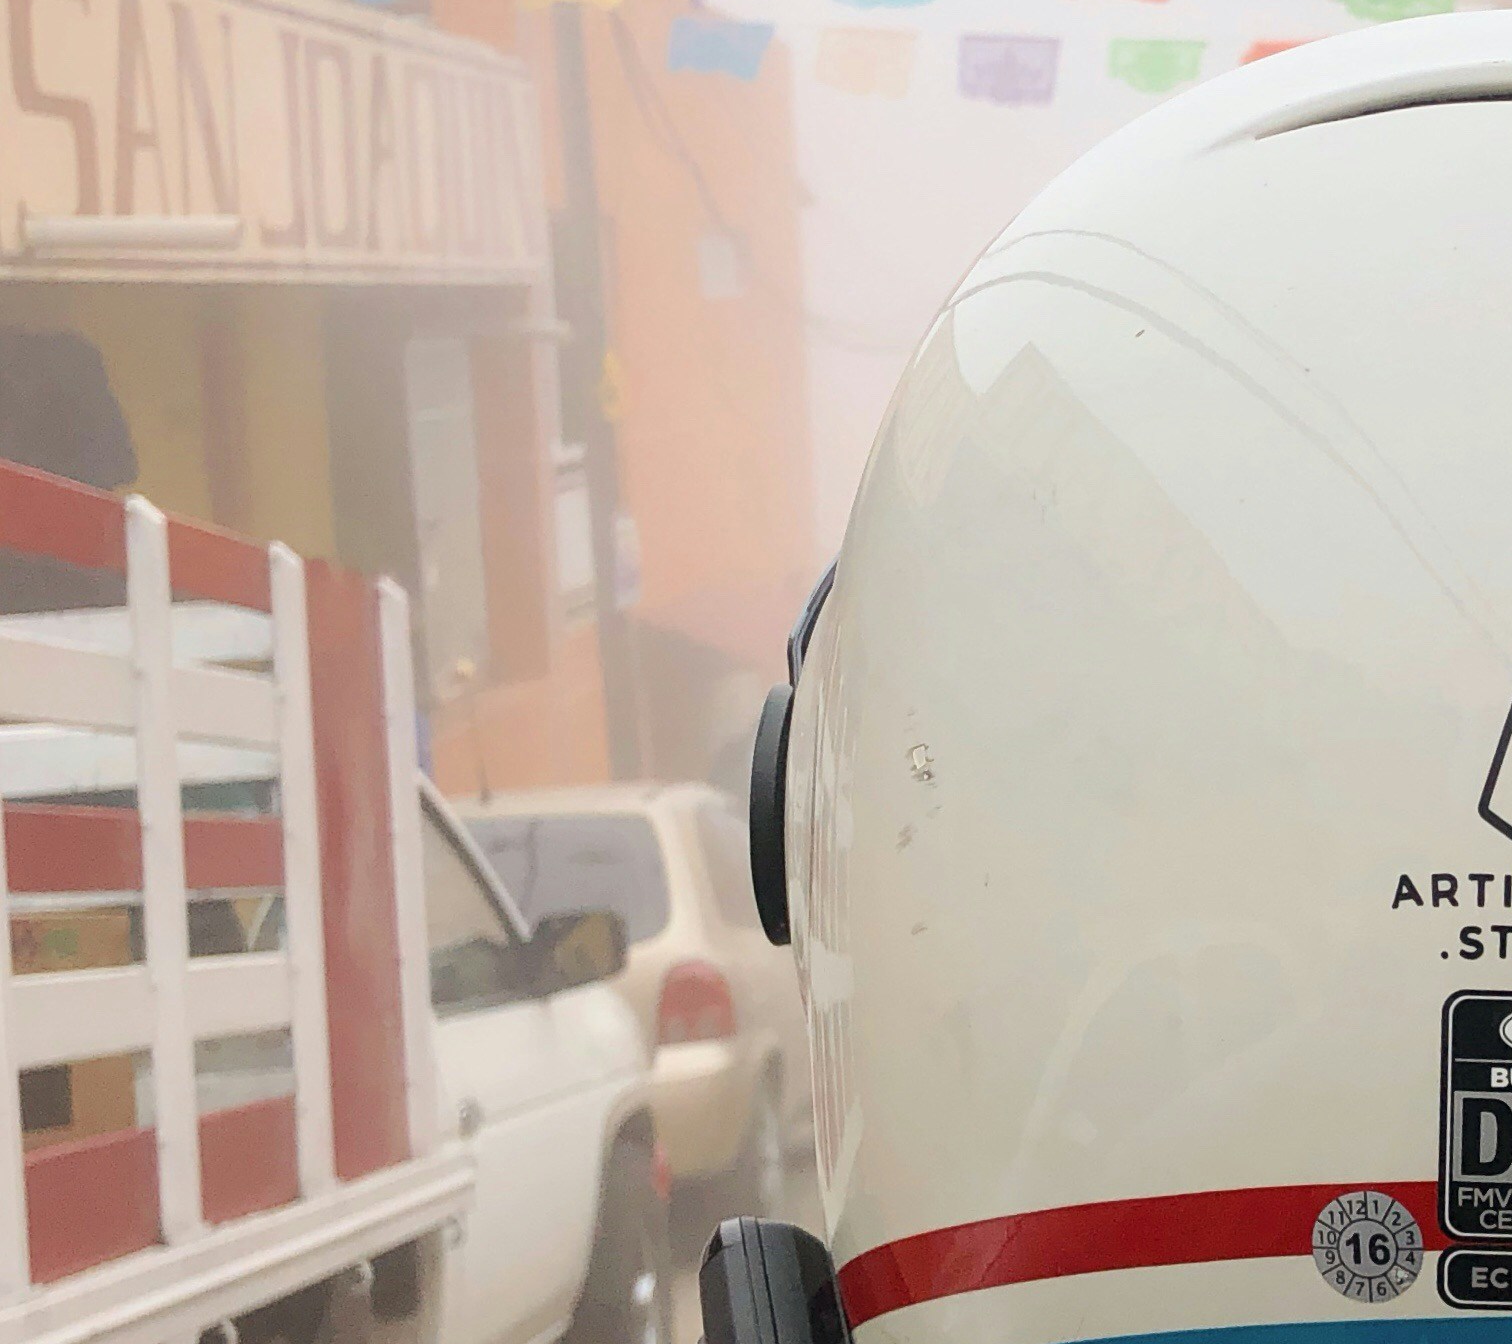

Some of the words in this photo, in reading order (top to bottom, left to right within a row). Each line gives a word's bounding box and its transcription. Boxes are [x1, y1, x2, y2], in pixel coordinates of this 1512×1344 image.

[1347, 1199, 1367, 1215] 12
[1372, 1199, 1379, 1215] 1
[1328, 1210, 1345, 1226] 11
[1391, 1211, 1402, 1226] 2
[1318, 1230, 1337, 1245] 10
[1405, 1230, 1415, 1245] 3
[1345, 1232, 1391, 1265] 16
[1325, 1250, 1336, 1265] 9
[1405, 1251, 1415, 1265] 4
[1335, 1270, 1346, 1285] 8
[1355, 1281, 1365, 1296] 7
[1376, 1281, 1387, 1296] 6
